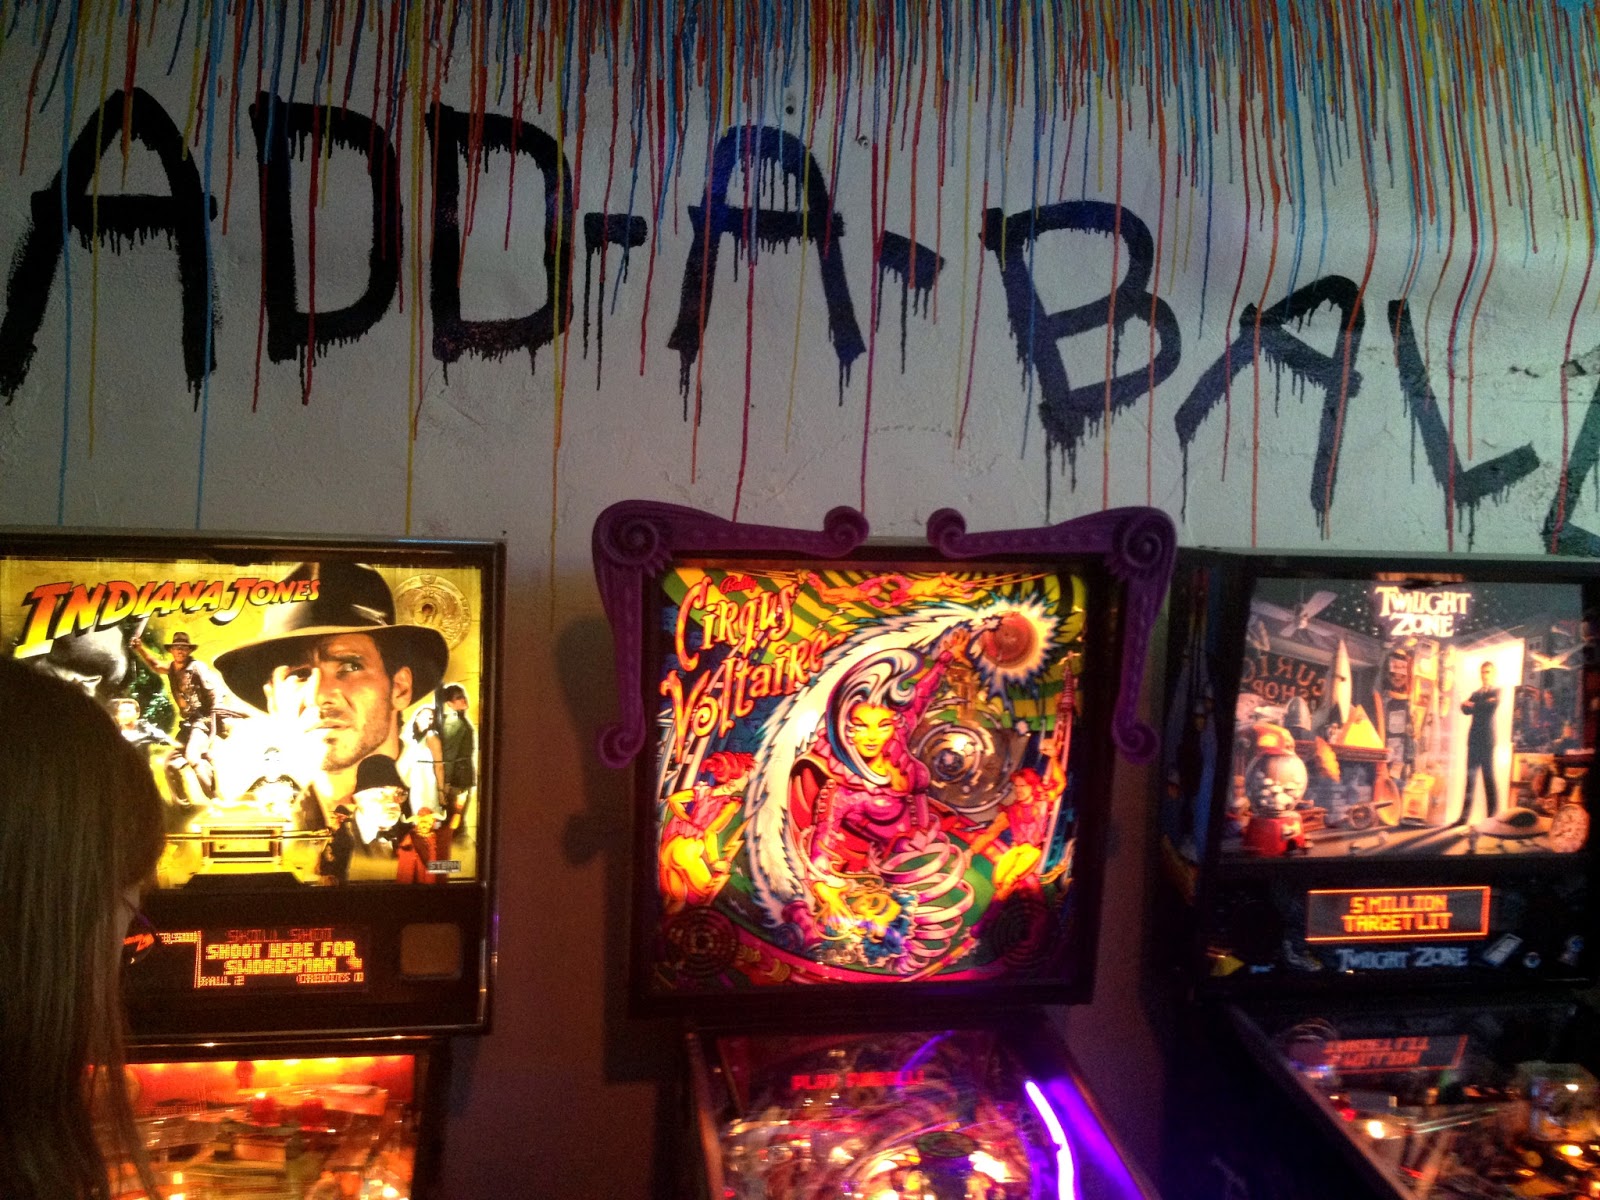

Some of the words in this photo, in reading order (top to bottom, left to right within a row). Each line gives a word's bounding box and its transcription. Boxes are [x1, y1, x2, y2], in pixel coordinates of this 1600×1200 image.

[1374, 586, 1472, 616] TWILIGHT
[14, 578, 224, 660] INDIANA
[209, 577, 321, 626] JONES
[1389, 611, 1455, 638] ZONE
[1366, 895, 1448, 913] MILLION
[1341, 914, 1413, 932] TARGET
[1413, 912, 1453, 930] LIT
[206, 943, 262, 960] SHOOT
[268, 942, 314, 958] HERE
[320, 940, 356, 957] FOR
[1411, 946, 1468, 967] ZONE
[224, 957, 337, 976] SWORDSMAN
